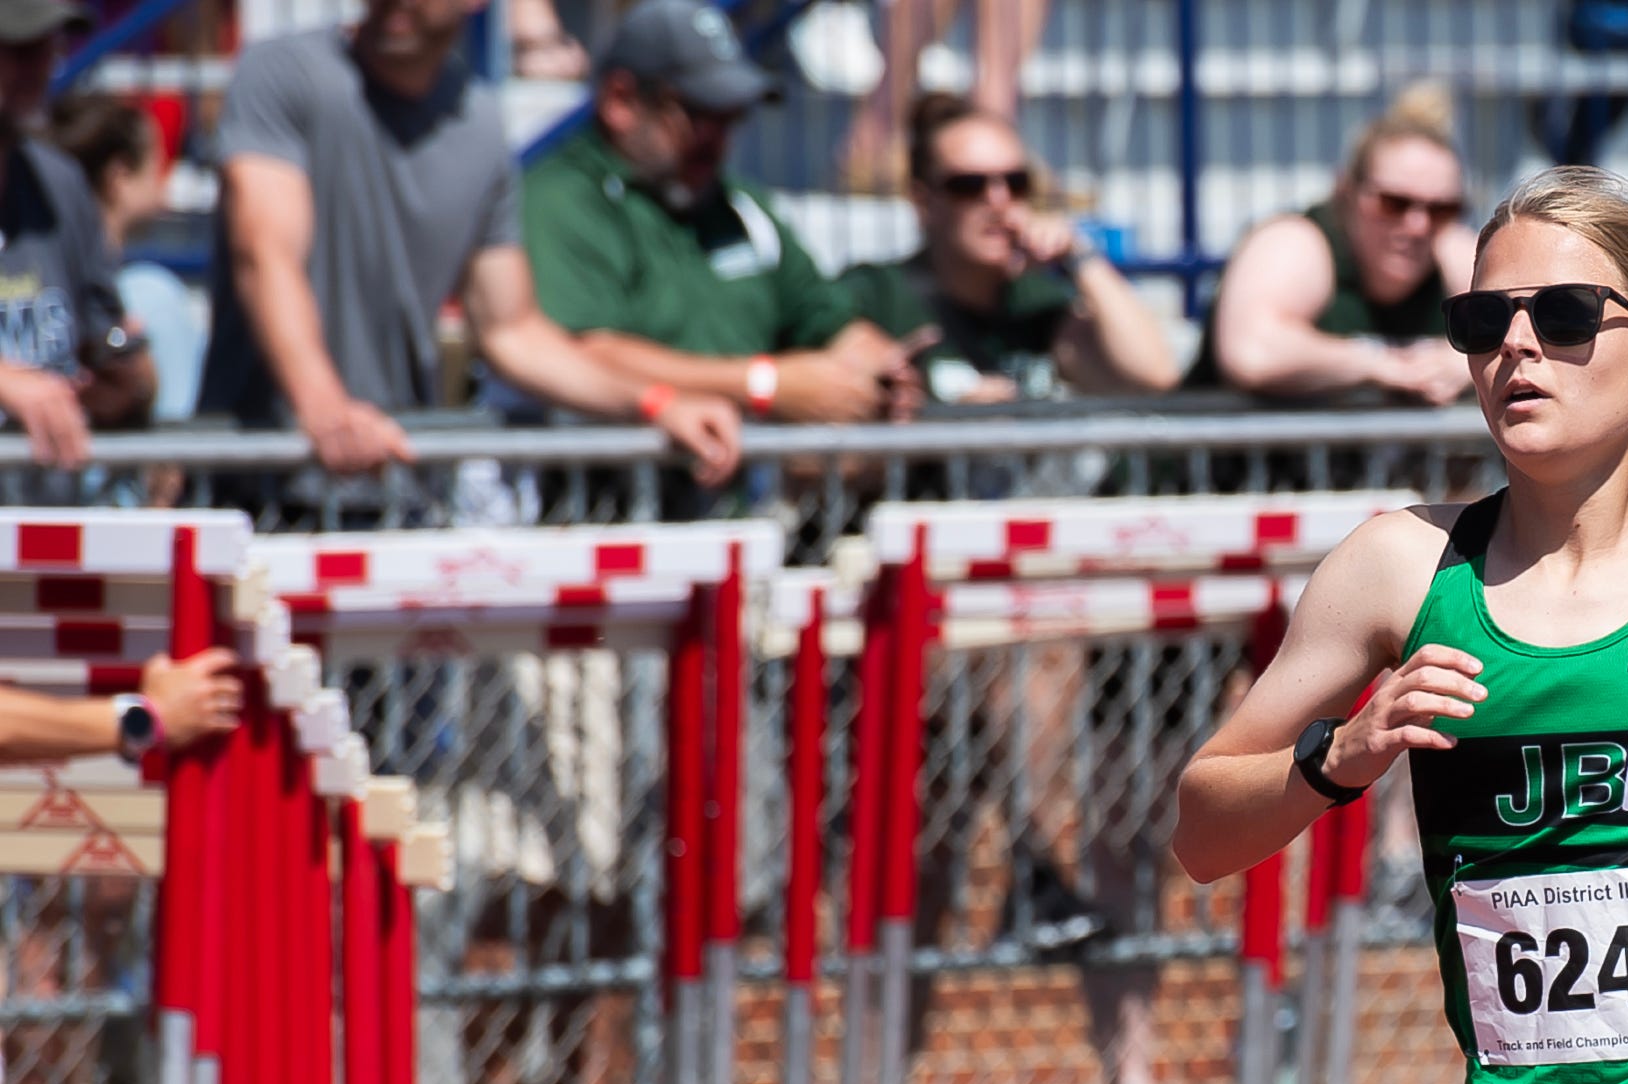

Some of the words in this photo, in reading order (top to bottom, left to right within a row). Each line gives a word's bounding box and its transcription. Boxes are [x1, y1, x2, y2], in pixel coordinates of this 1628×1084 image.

[1491, 889, 1538, 909] PIAA
[1543, 885, 1612, 904] District
[1526, 1041, 1544, 1050] and
[1547, 1038, 1573, 1049] Field
